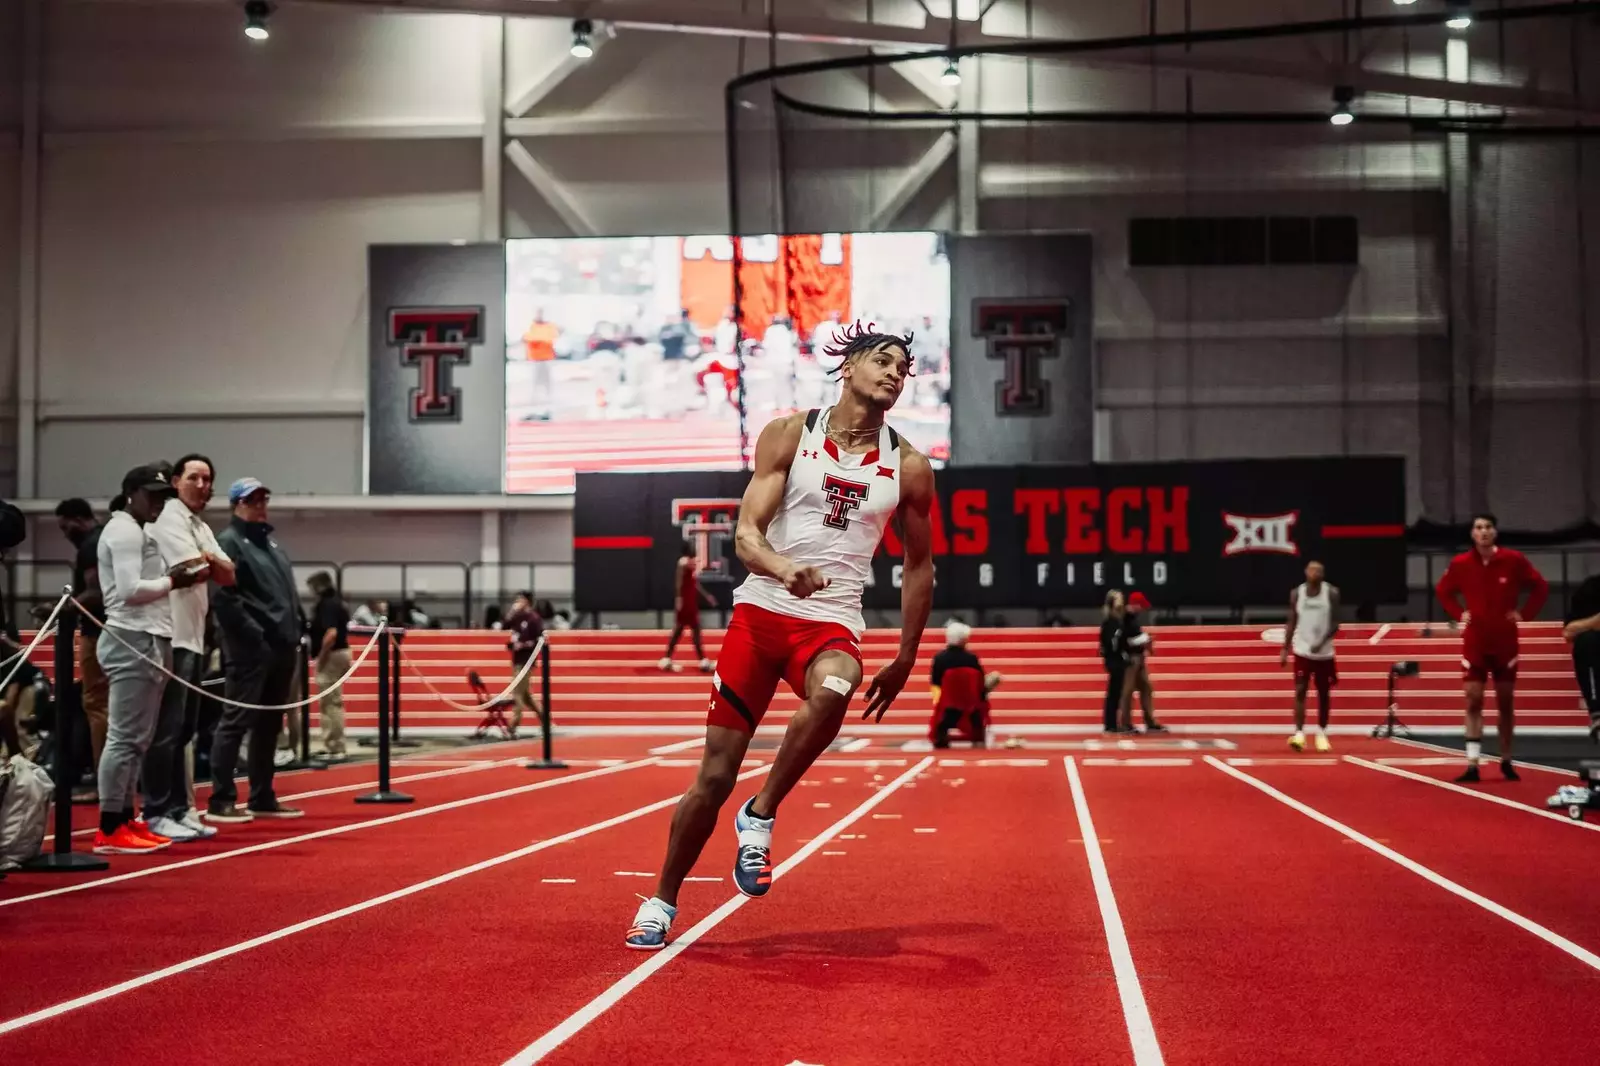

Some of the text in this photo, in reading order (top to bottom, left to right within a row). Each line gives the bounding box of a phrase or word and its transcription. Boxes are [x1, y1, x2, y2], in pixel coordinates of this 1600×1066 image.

[1013, 485, 1190, 555] TECH
[1221, 509, 1300, 557] XII
[1036, 560, 1168, 587] FIELD
